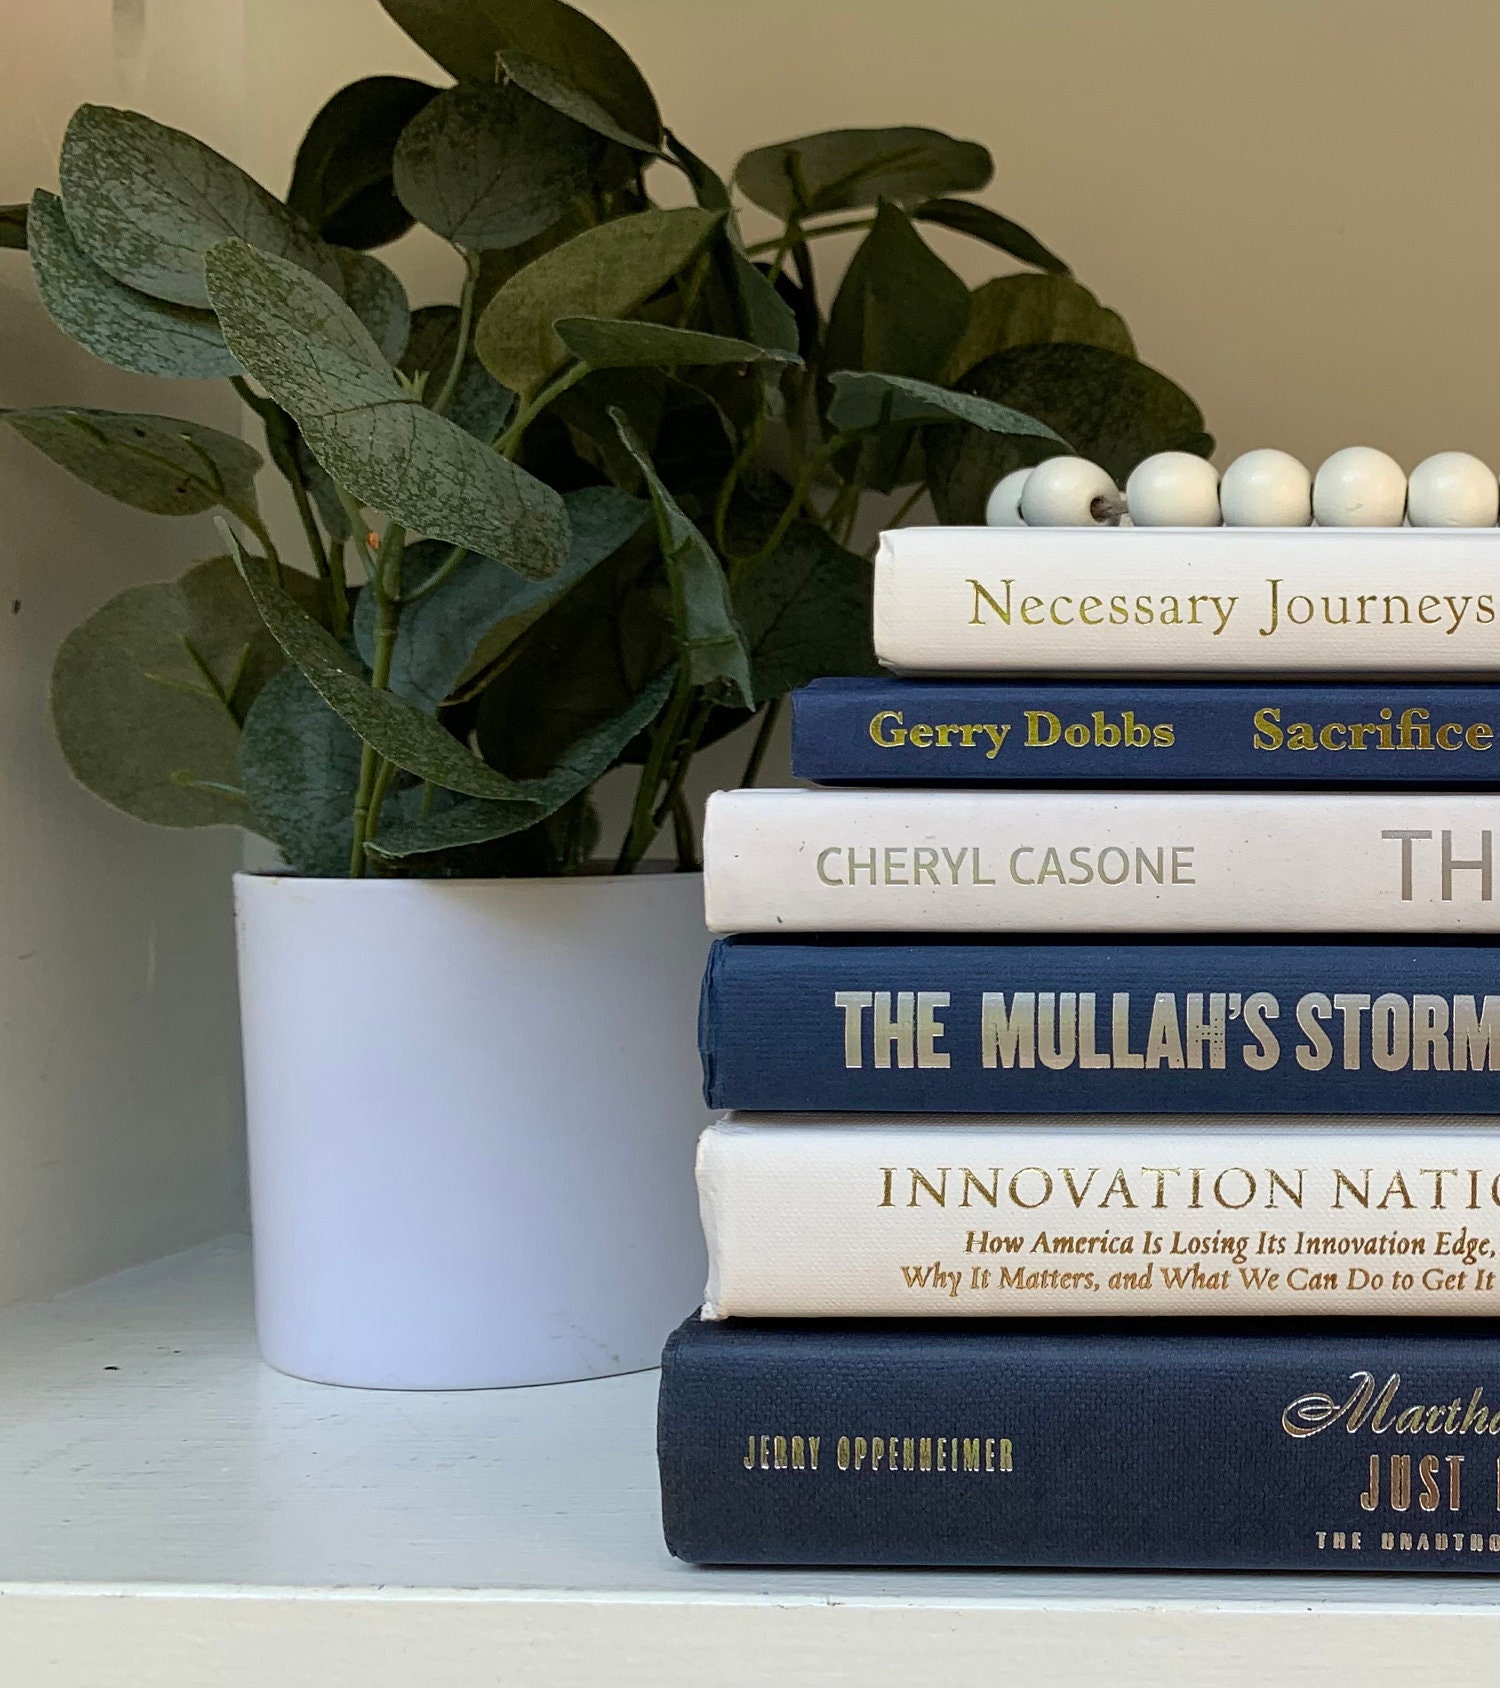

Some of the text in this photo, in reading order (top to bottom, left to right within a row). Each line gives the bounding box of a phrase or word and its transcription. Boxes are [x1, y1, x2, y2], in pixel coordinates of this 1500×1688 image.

[965, 578, 1496, 636] Necessary Journeys
[869, 710, 1176, 760] Gerry Dobbs
[1252, 707, 1494, 752] Sacrifice
[816, 846, 1197, 887] CHERYL CASONE
[835, 990, 952, 1070] THE
[981, 991, 1281, 1072] MULLAH'S
[877, 1166, 1305, 1210] INNOVATION
[963, 1226, 1496, 1265] How America Is Losing Its Innovation Edge,
[900, 1260, 962, 1298] Why
[969, 1266, 991, 1290] It
[998, 1265, 1101, 1292] Matters,
[1108, 1262, 1153, 1290] and
[1160, 1262, 1230, 1291] What
[1238, 1267, 1280, 1291] We
[1286, 1267, 1338, 1291] Can
[1346, 1267, 1384, 1291] Do
[1391, 1269, 1415, 1291] to
[1422, 1268, 1466, 1291] Get
[1474, 1268, 1496, 1291] It
[743, 1434, 1014, 1473] JERRY OPPENHEIMER
[1360, 1453, 1467, 1513] JUST
[1315, 1531, 1363, 1551] THE
